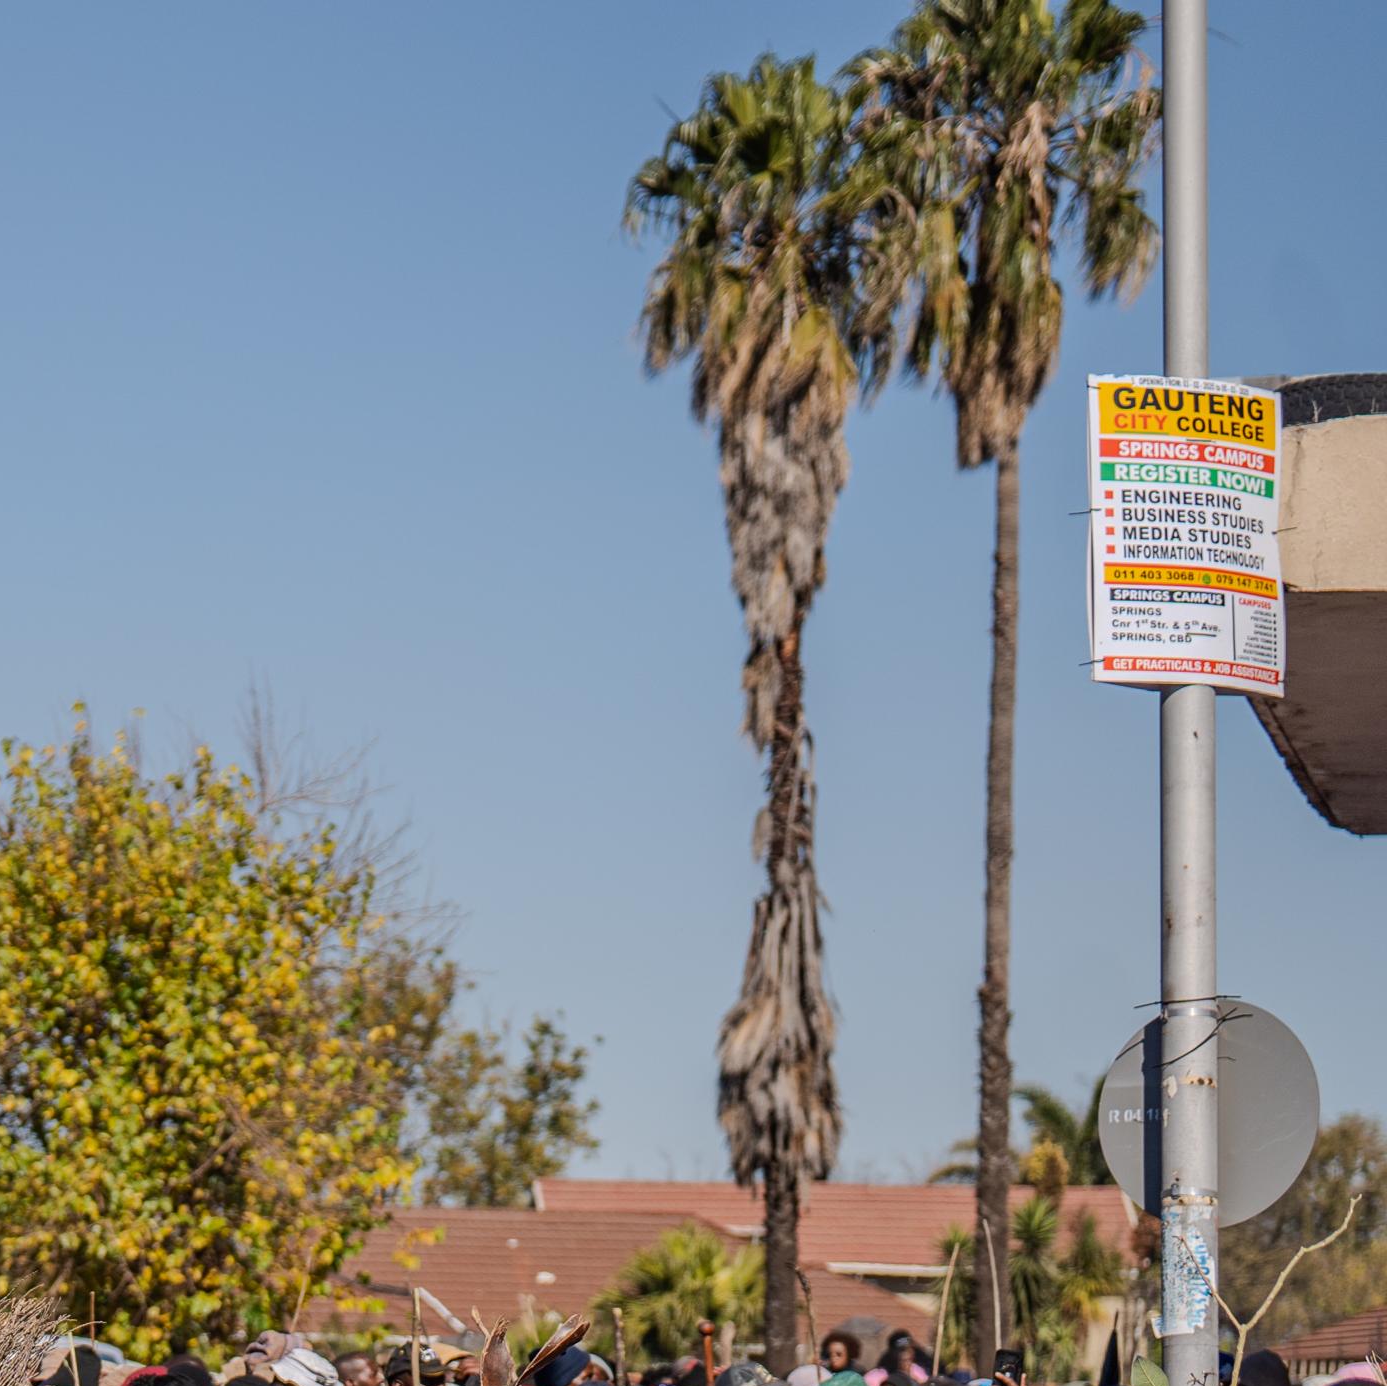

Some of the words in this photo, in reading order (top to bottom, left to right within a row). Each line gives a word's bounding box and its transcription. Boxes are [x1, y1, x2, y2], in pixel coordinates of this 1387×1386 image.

[1113, 387, 1264, 422] GAUTENG
[1113, 412, 1167, 430] CITY
[1176, 416, 1264, 442] COLLEGE
[1118, 441, 1199, 461] SPRINGS
[1203, 446, 1265, 470] CAMPUS
[1114, 463, 1211, 486] REGISTER
[1216, 473, 1266, 496] NOW!
[1121, 489, 1242, 511] ENGINEERING
[1122, 508, 1206, 524] BUSINESS
[1212, 512, 1264, 534] STUDIES
[1123, 526, 1181, 541] MEDIA
[1188, 529, 1252, 549] STUDIES
[1123, 544, 1203, 561] INFORMATION
[1207, 548, 1265, 571] TECHNOLOGY
[1113, 570, 1135, 579] 011
[1140, 570, 1162, 580] 403
[1166, 570, 1194, 581] 3068
[1215, 575, 1233, 585] 079
[1237, 577, 1252, 588] 147
[1254, 579, 1274, 593] 3741
[1113, 589, 1170, 601] SPRINGS
[1173, 591, 1223, 605] CAMPUS
[1111, 606, 1162, 616] SPRINGS
[1111, 619, 1130, 628] Cnr
[1150, 620, 1169, 630] Str.
[1172, 622, 1180, 630] &
[1201, 623, 1221, 632] Ave.
[1111, 631, 1166, 644] SPRINGS,
[1169, 633, 1192, 643] CBD
[1112, 658, 1134, 670] GET
[1135, 658, 1201, 672] PRACTICALS
[1203, 662, 1212, 672] &
[1213, 662, 1230, 676] JOB
